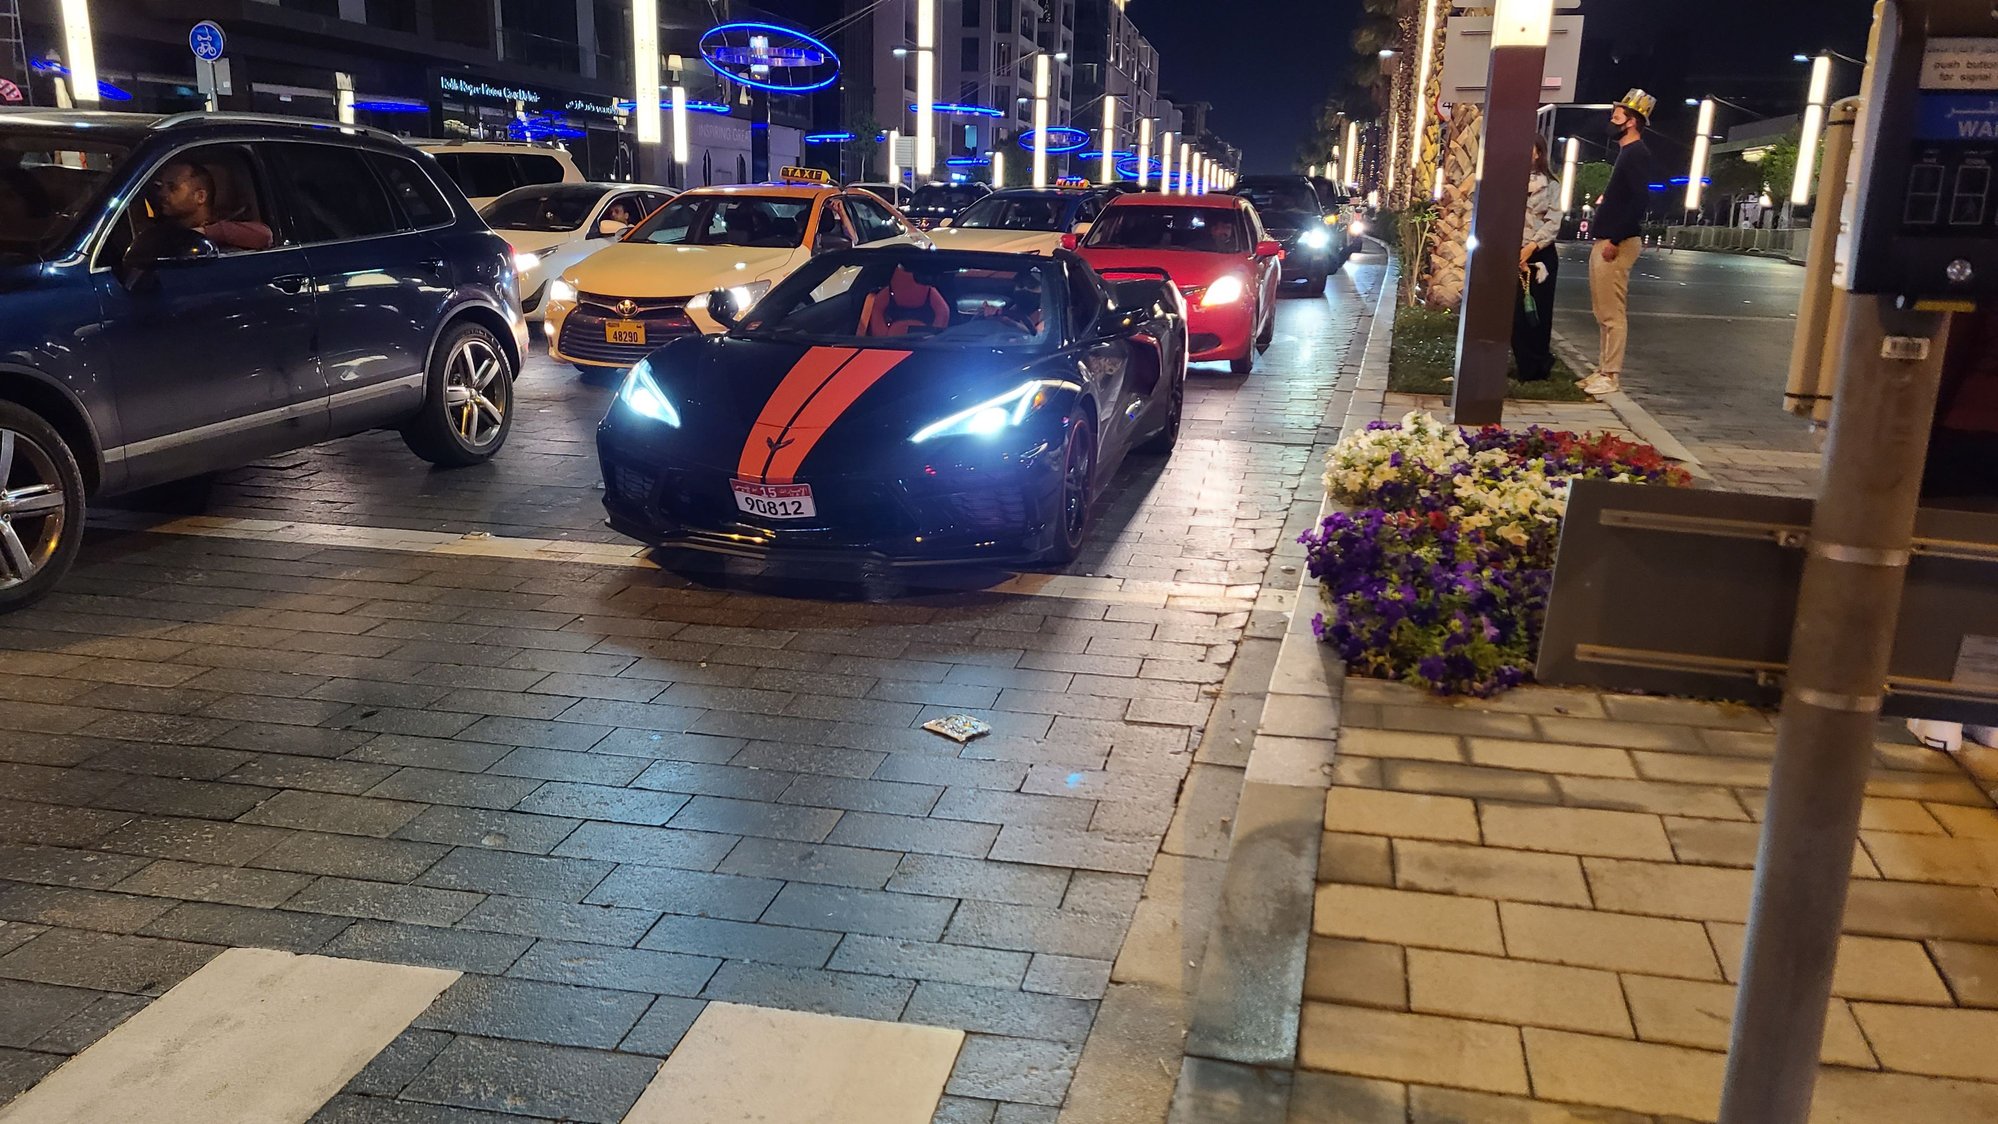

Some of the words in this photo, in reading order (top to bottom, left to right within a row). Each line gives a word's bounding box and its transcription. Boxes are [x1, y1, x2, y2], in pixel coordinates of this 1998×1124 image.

[1934, 61, 1960, 70] push
[1939, 73, 1954, 81] for
[787, 168, 816, 179] TAXI
[613, 331, 638, 342] 48290
[759, 487, 777, 498] 15
[745, 497, 804, 515] 90812
